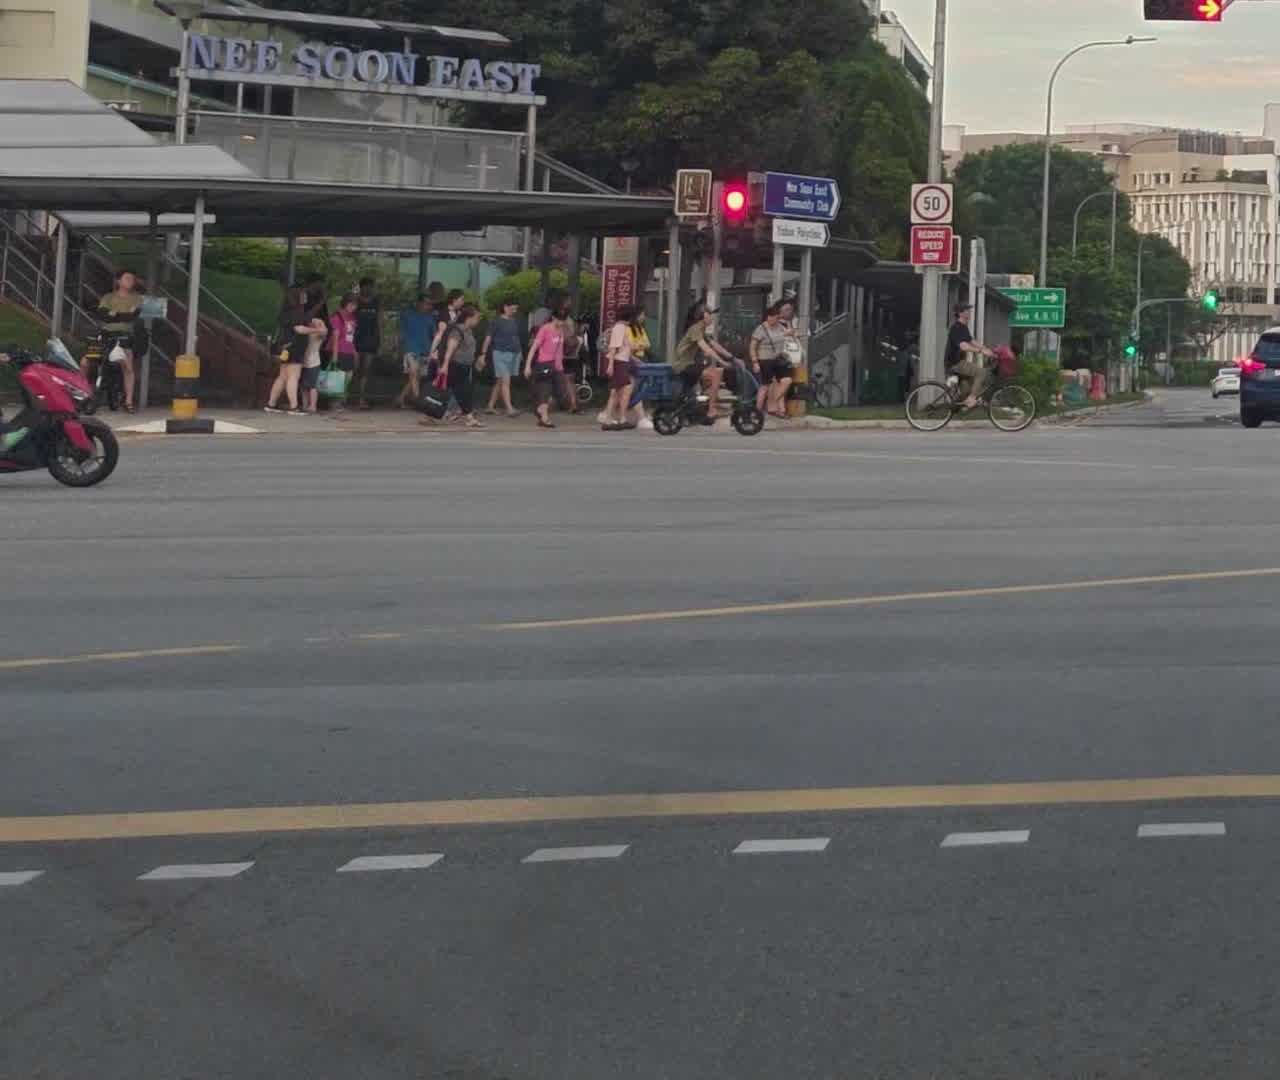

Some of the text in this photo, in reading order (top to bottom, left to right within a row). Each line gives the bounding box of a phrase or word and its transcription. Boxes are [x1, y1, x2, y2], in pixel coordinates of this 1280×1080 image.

[188, 34, 542, 95] NEE SOON EAST
[923, 196, 940, 211] 50
